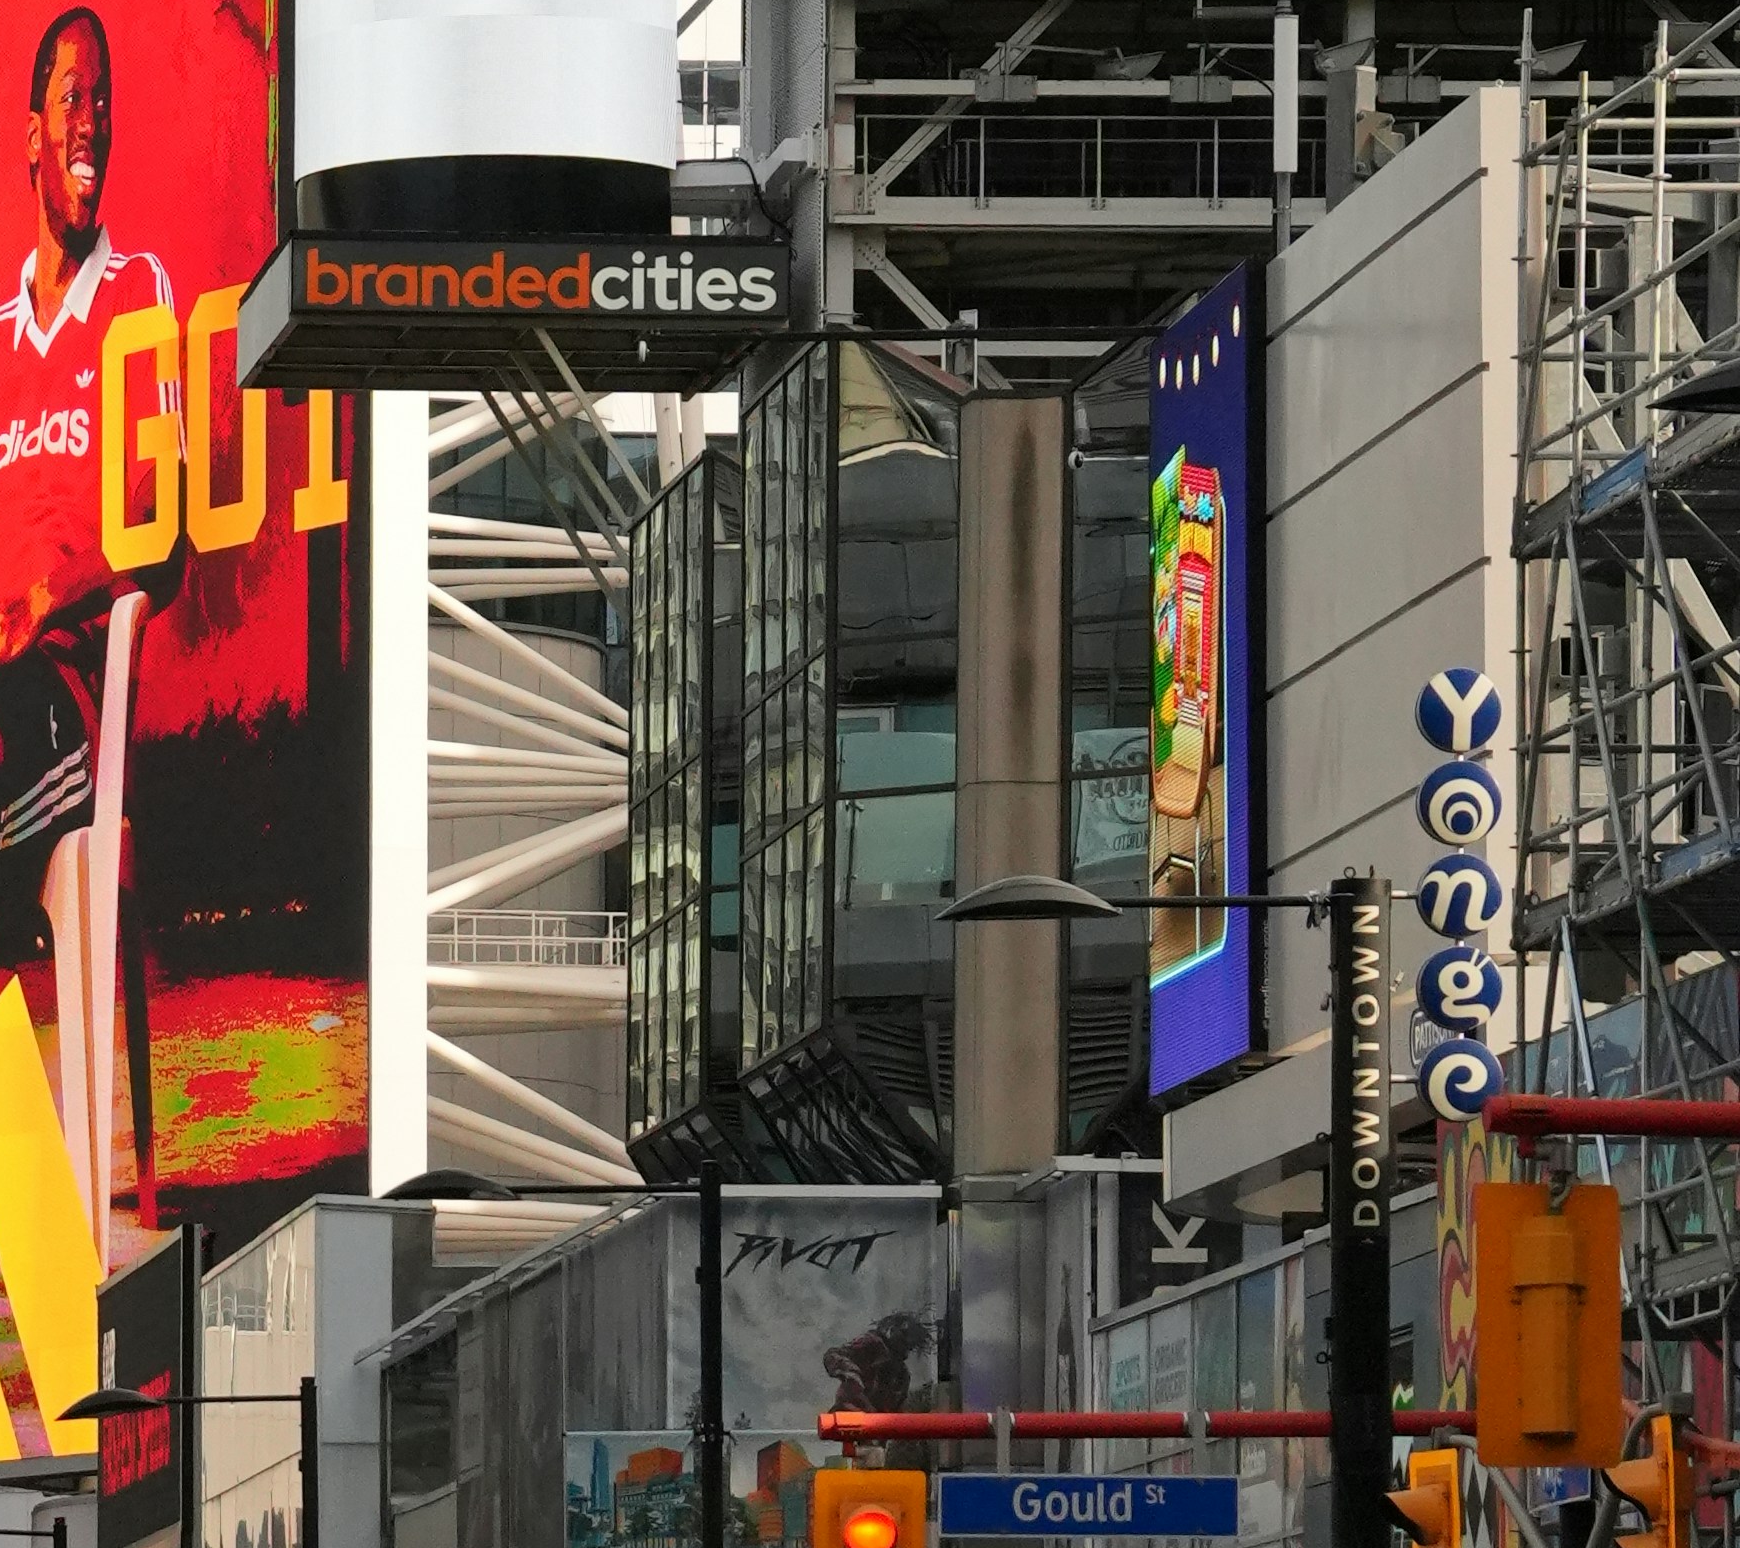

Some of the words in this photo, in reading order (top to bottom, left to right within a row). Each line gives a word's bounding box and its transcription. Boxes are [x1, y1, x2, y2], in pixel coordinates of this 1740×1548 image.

[305, 249, 777, 313] brandedcities
[1419, 669, 1503, 1122] Yonge
[1350, 903, 1381, 1228] DOWNTOWN
[722, 1229, 900, 1279] PIVOT
[1012, 1483, 1133, 1523] Gould
[1144, 1483, 1167, 1506] St
